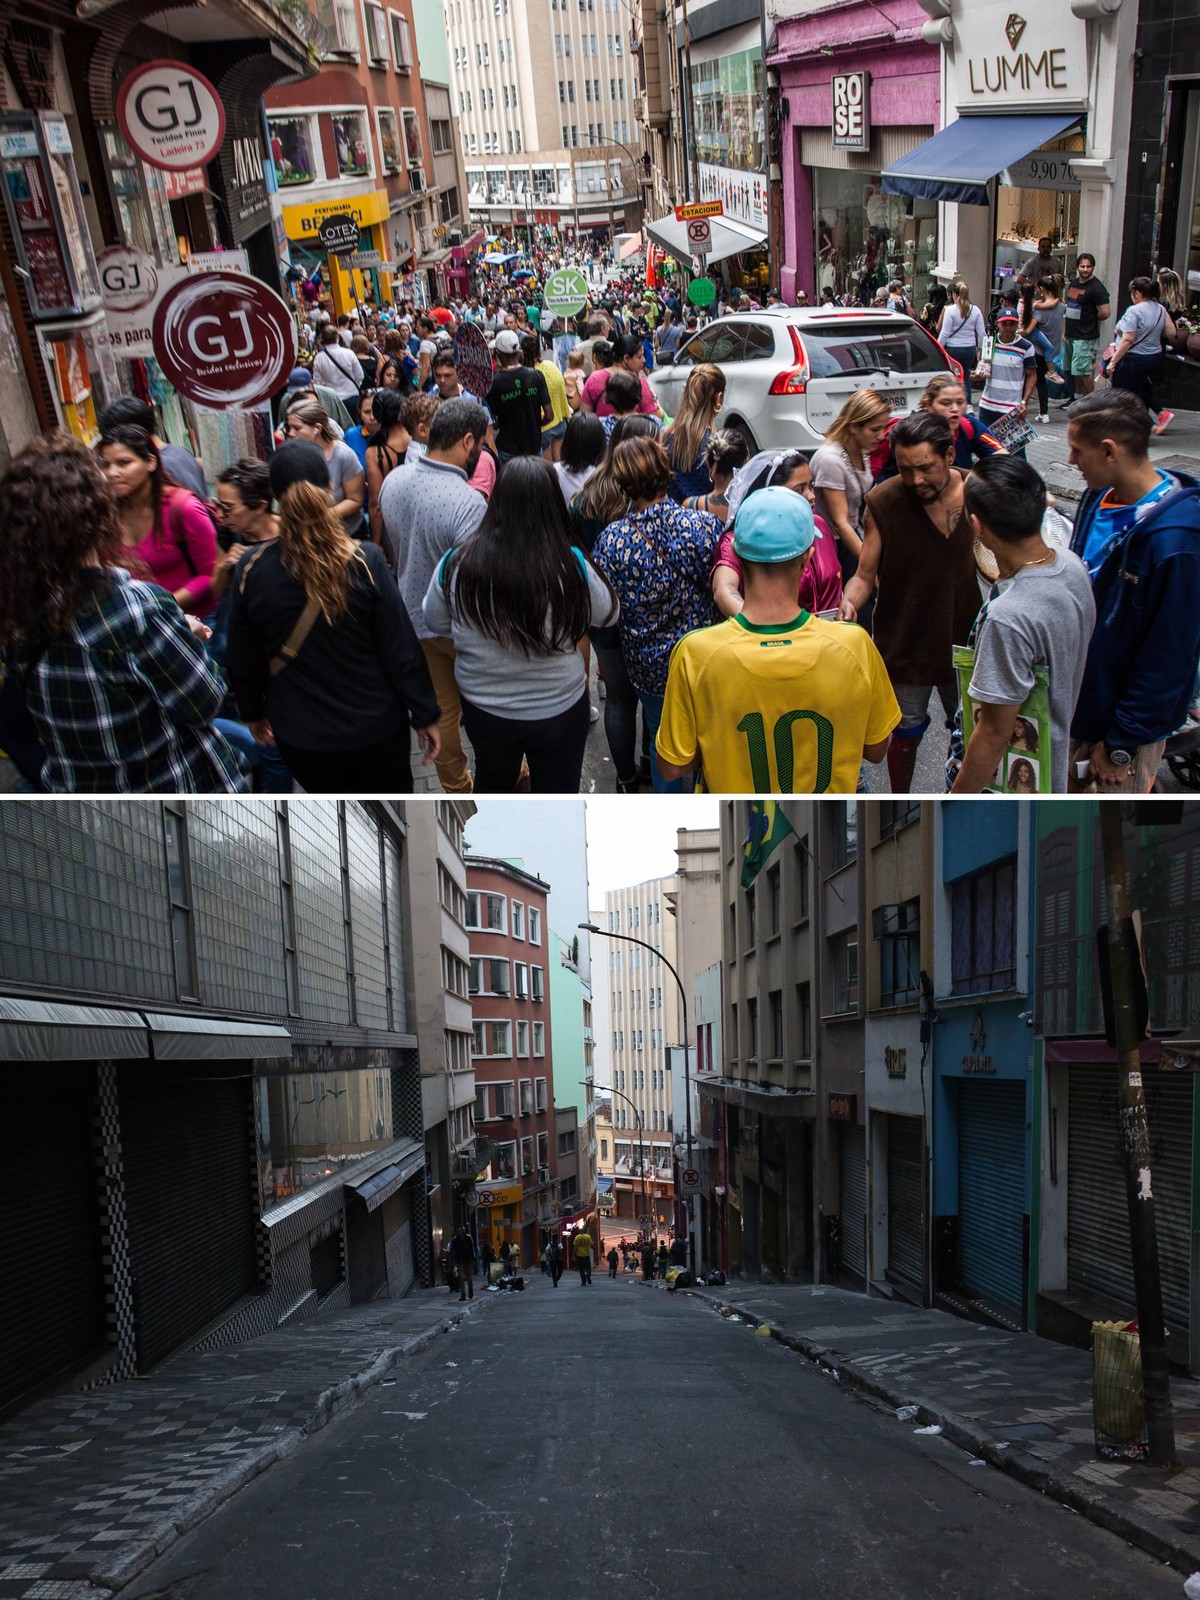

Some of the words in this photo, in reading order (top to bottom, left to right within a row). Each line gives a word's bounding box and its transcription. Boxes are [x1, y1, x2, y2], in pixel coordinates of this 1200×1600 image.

[969, 48, 1067, 94] LUMME
[135, 79, 202, 132] GJ
[160, 144, 192, 158] Ladeira
[194, 141, 206, 151] 73
[1030, 160, 1057, 182] 9,90
[314, 204, 352, 214] PERFUMARIA
[682, 205, 720, 216] ESTACIONE
[319, 222, 358, 241] LOTEX
[102, 264, 140, 291] GJ
[552, 276, 579, 295] SK
[125, 327, 153, 347] para
[187, 310, 255, 362] GJ
[737, 709, 834, 793] 10
